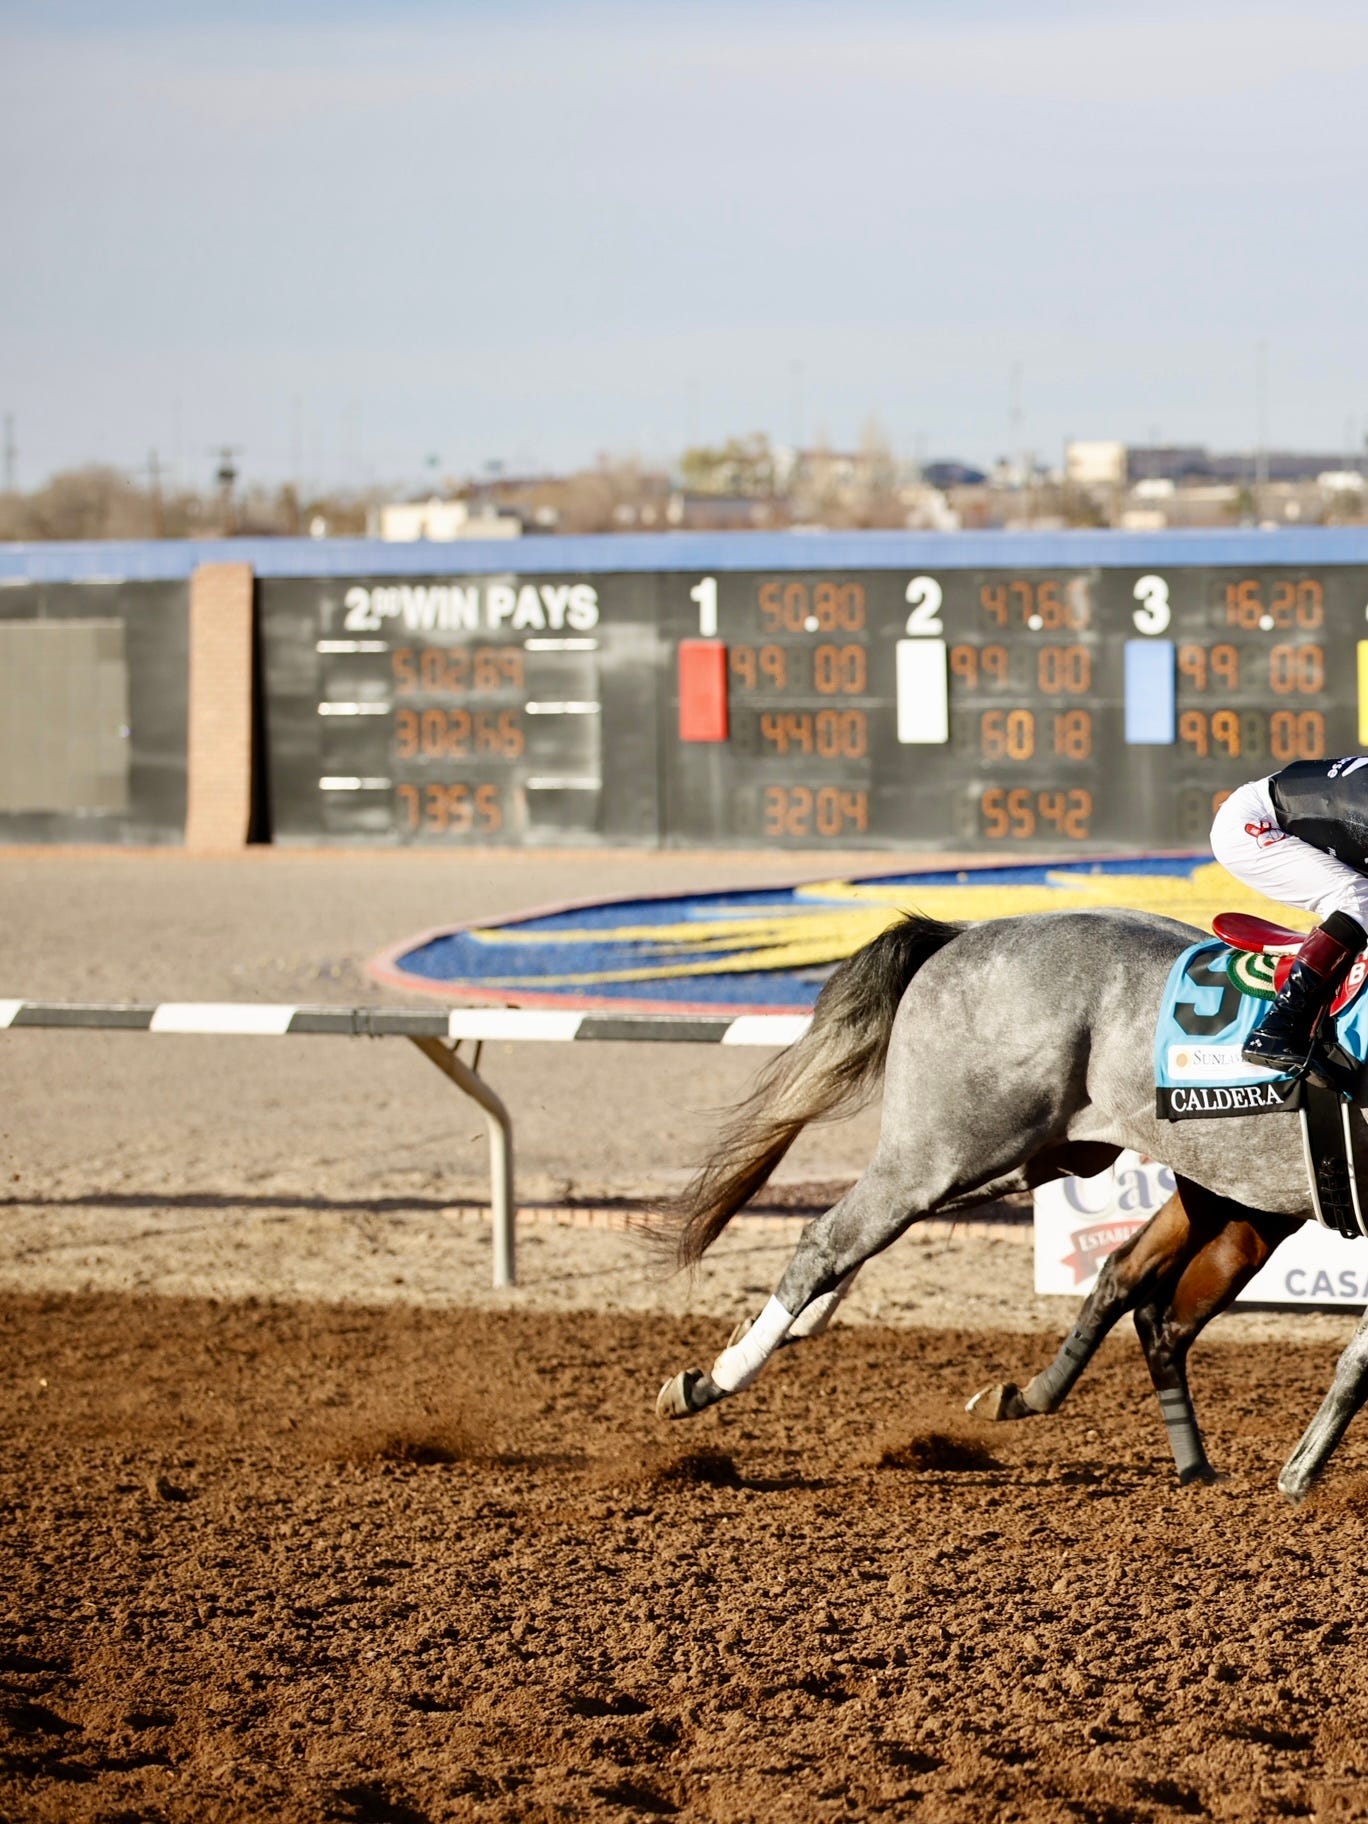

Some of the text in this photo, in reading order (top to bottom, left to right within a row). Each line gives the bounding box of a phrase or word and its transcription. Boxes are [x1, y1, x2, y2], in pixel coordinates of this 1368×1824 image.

[399, 585, 480, 631] WIN
[486, 583, 599, 631] PAYS
[690, 577, 717, 637] 1
[905, 576, 943, 636] 2
[1133, 574, 1171, 636] 3
[1170, 1083, 1284, 1112] CALDERA
